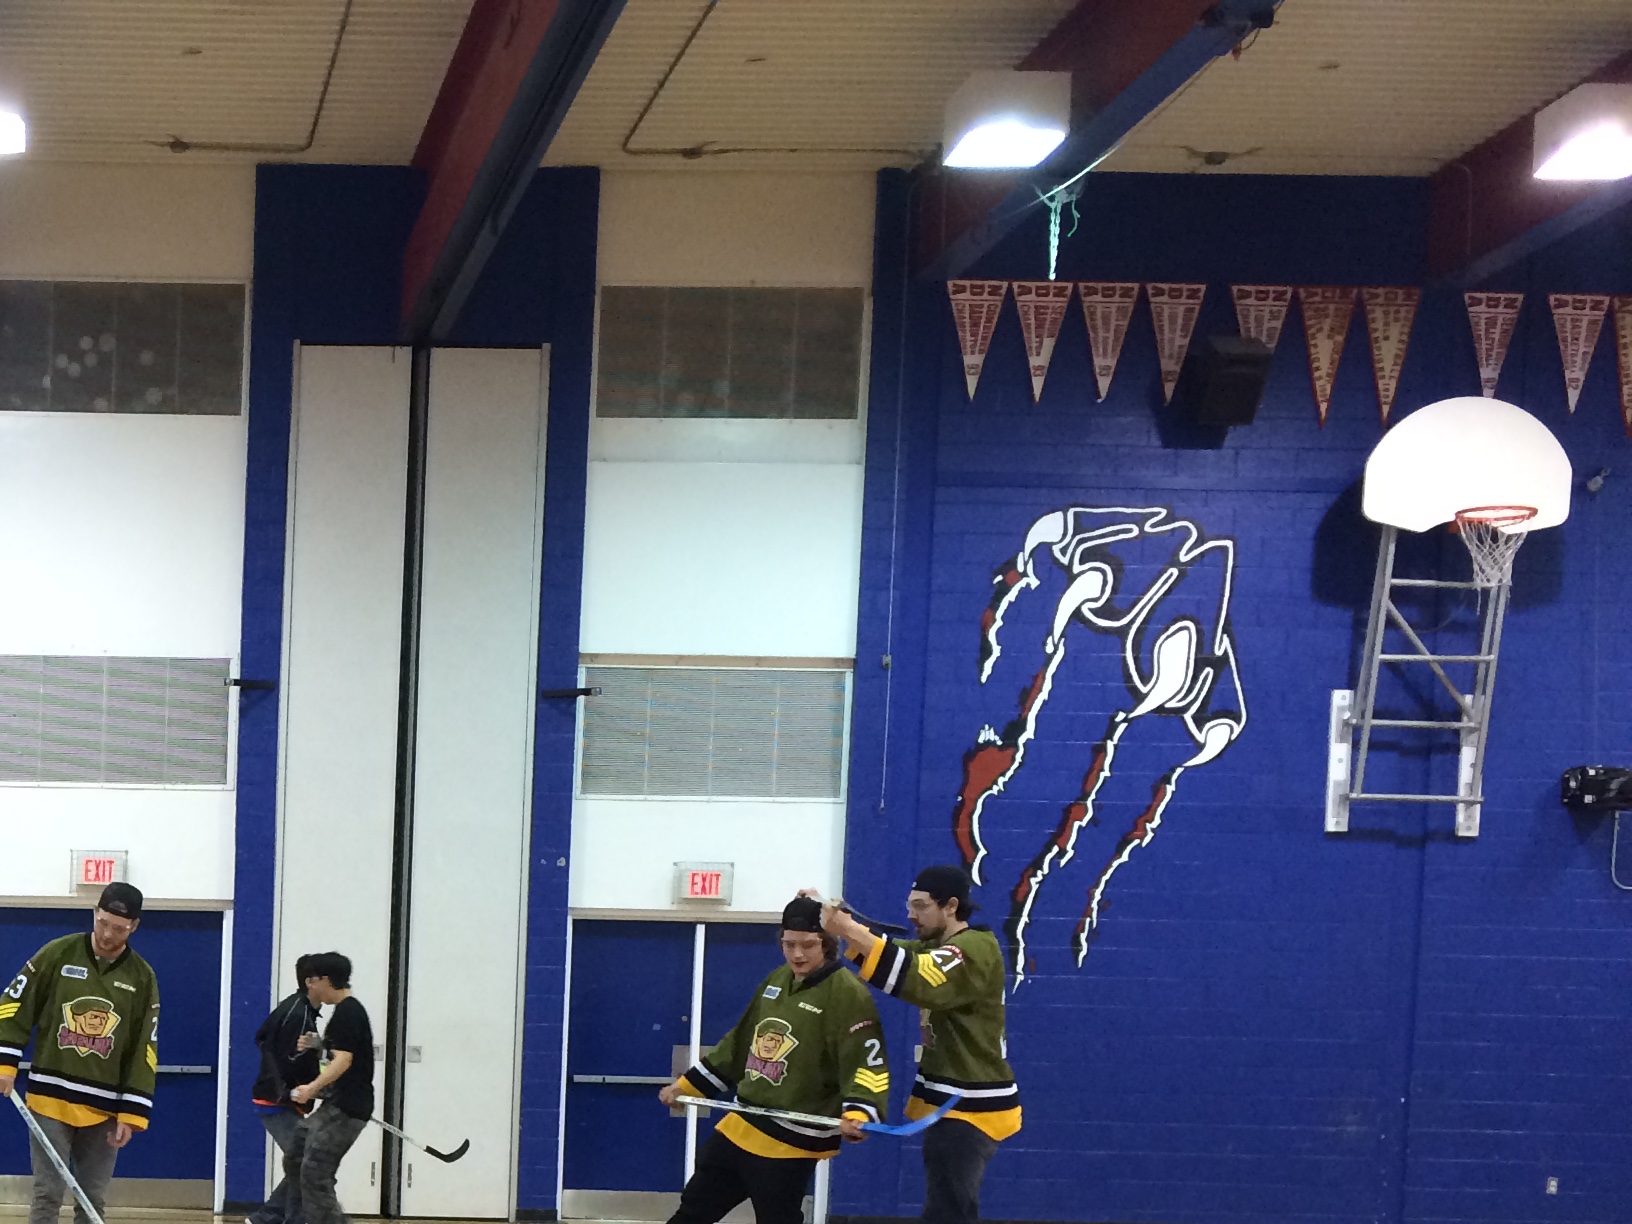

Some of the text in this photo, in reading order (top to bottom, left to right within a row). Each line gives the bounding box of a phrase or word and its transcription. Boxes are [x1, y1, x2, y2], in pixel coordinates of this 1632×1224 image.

[85, 859, 115, 882] EXIT
[690, 872, 721, 896] EXIT
[864, 1038, 884, 1067] 2
